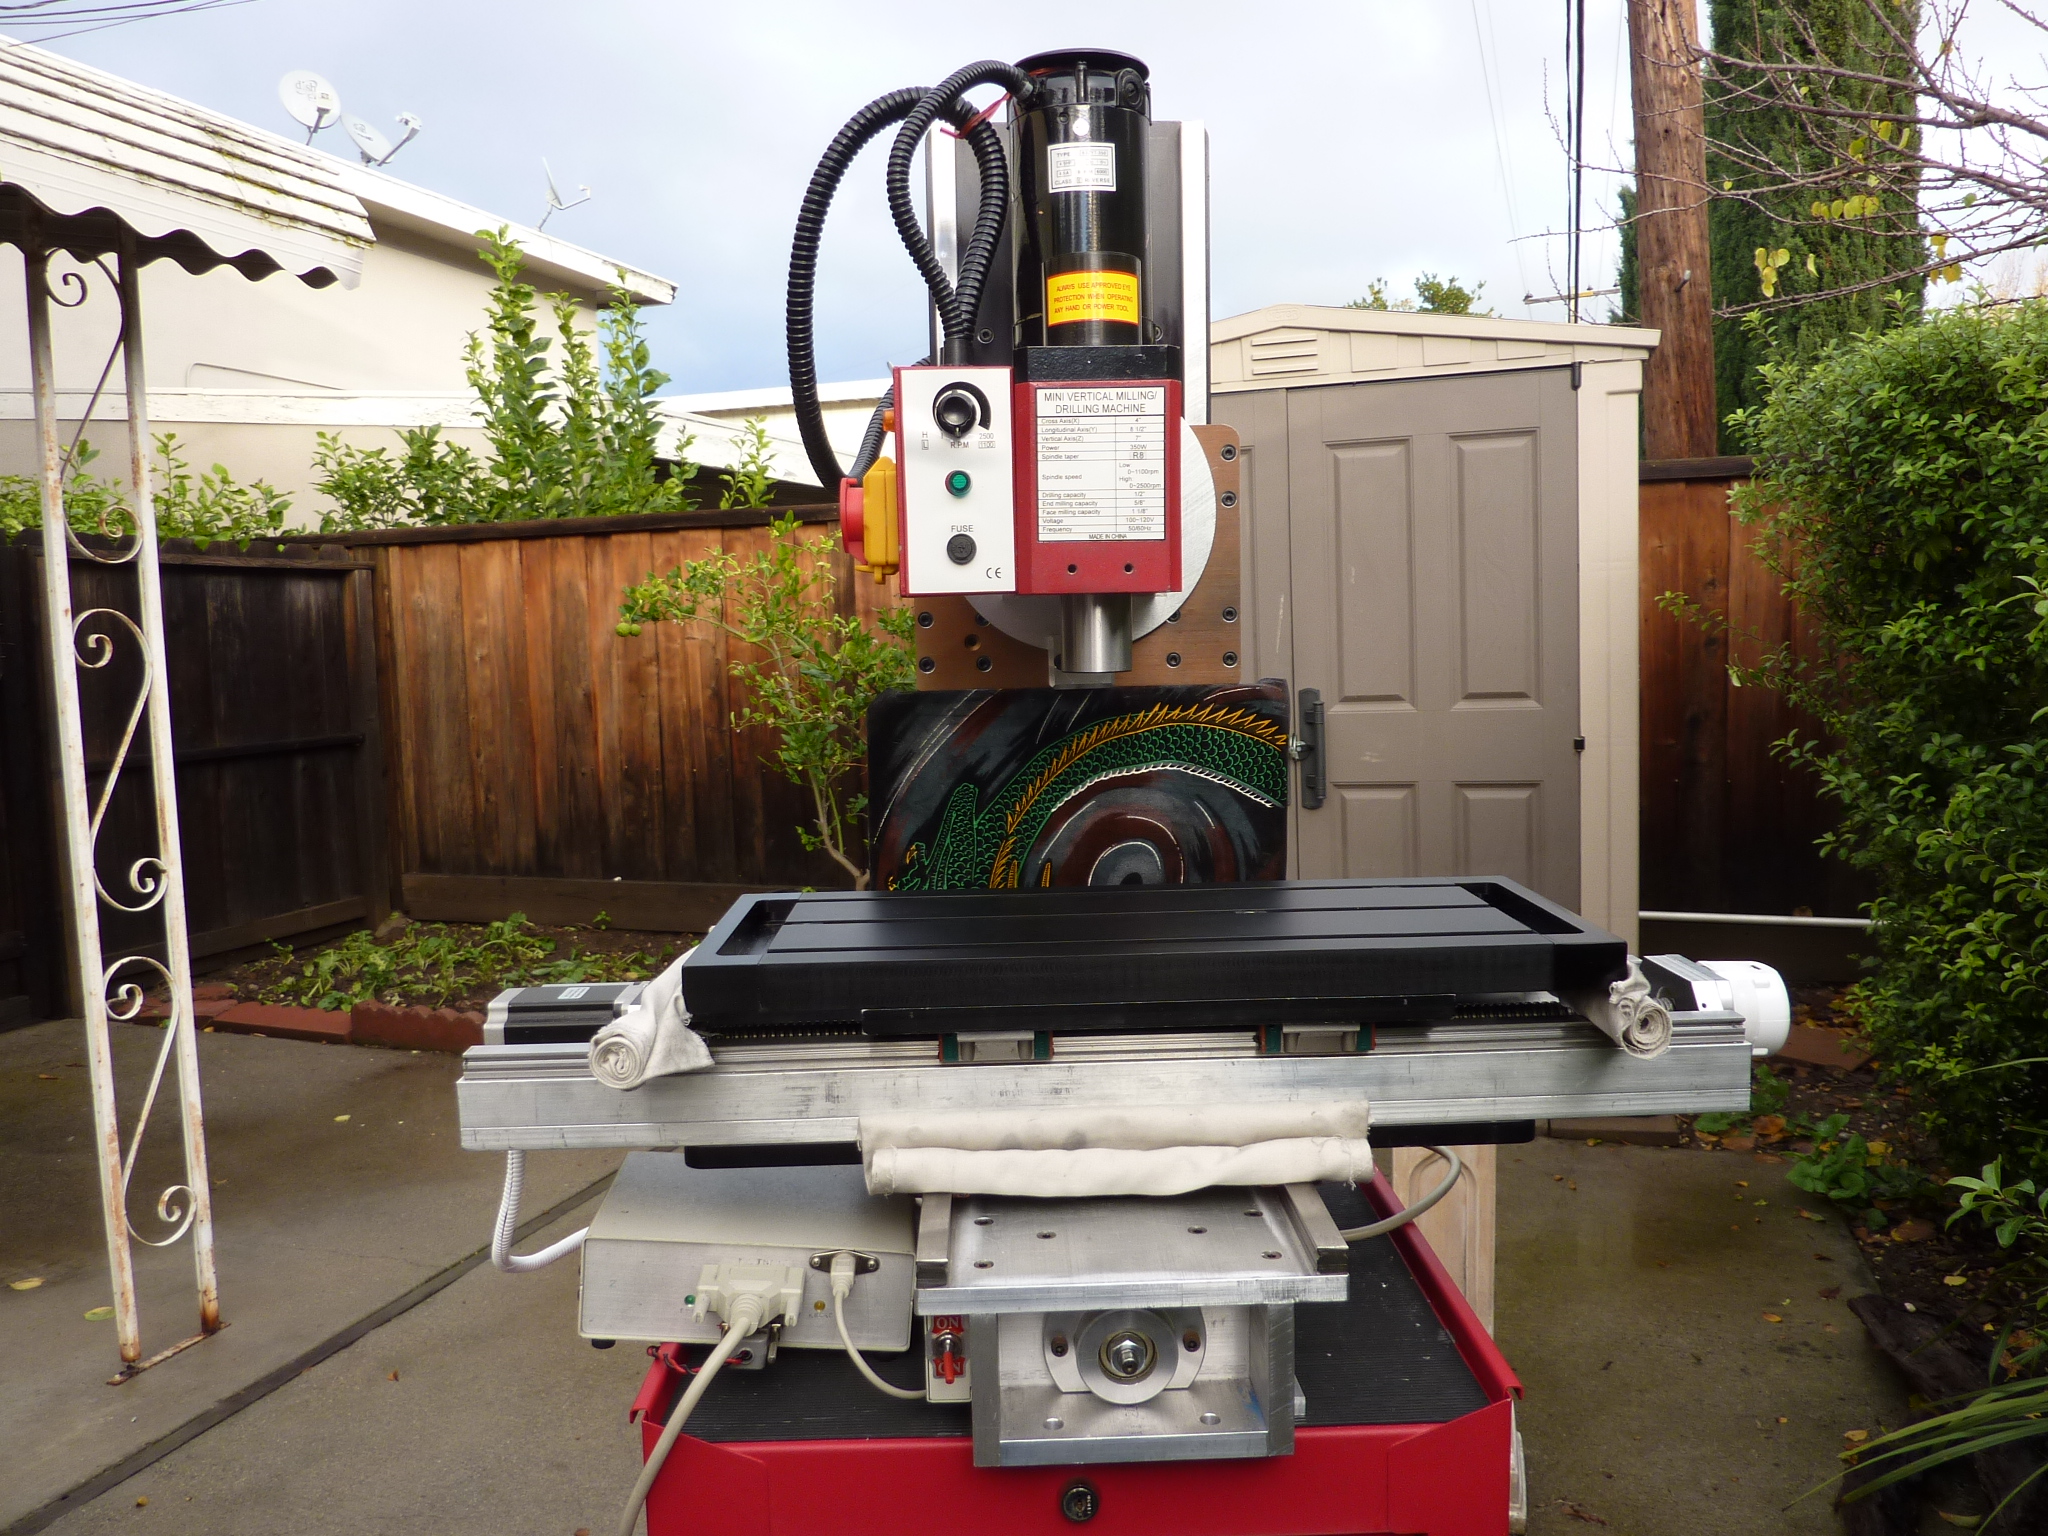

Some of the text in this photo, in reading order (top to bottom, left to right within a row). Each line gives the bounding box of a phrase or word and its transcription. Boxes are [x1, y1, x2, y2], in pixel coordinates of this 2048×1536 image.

[295, 80, 316, 92] dish
[1054, 294, 1085, 303] PROTECTION
[1107, 294, 1133, 302] OPERATING
[1044, 391, 1157, 401] MINI VERTICAL MILLING/
[1056, 404, 1146, 414] DRILLING MACHINE
[986, 567, 1001, 578] CE
[936, 1317, 959, 1329] ON
[938, 1362, 960, 1374] ON
